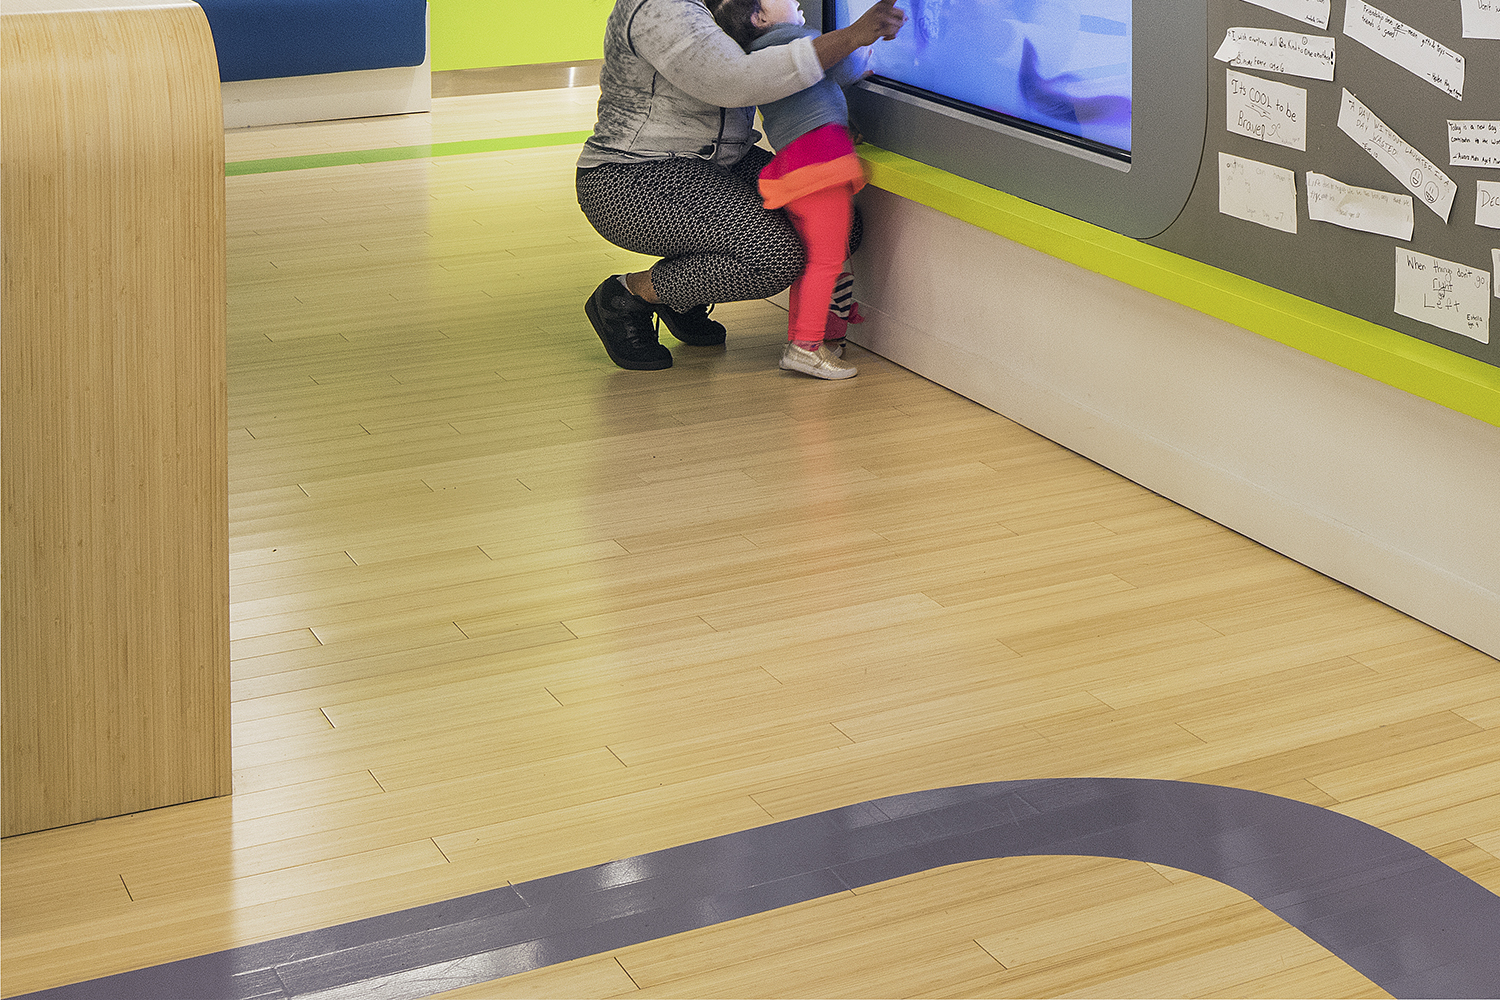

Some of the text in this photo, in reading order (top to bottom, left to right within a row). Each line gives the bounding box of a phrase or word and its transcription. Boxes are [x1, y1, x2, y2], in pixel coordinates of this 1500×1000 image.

[1249, 88, 1296, 122] COOL to be
[1406, 255, 1426, 271] When
[1474, 276, 1485, 288] go
